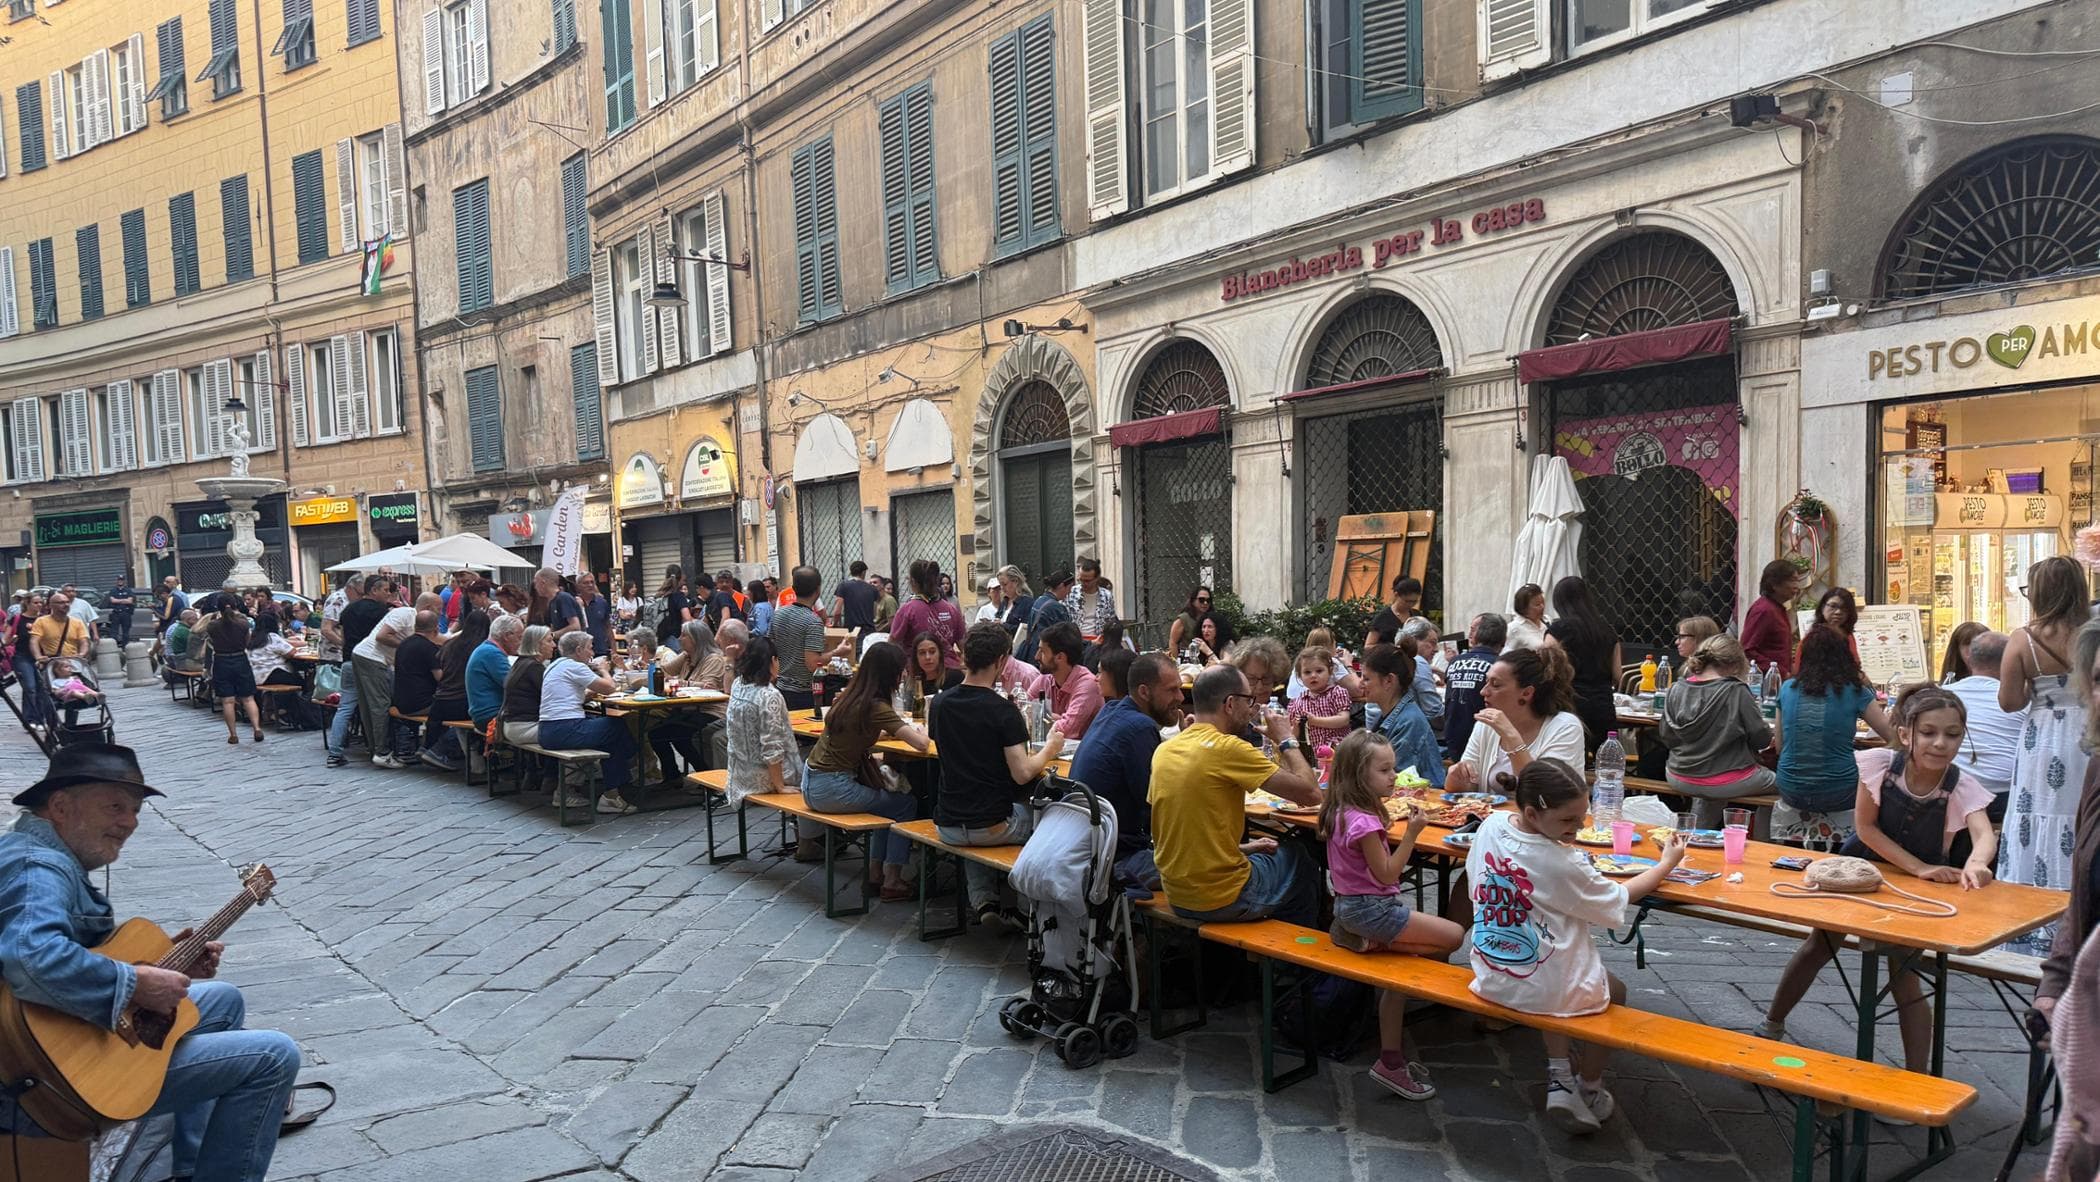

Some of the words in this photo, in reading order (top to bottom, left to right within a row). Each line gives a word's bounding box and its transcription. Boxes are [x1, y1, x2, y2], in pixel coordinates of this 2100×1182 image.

[1221, 243, 1363, 300] Biancheria
[1373, 228, 1424, 268] per
[1430, 218, 1462, 246] la
[1471, 198, 1546, 235] casa
[1868, 336, 1982, 381] PESTO
[2001, 337, 2028, 353] PER
[1615, 451, 1665, 474] BOLLO
[295, 501, 349, 519] FASTWEB
[382, 504, 416, 520] express
[64, 520, 120, 536] MAGLIERIE
[553, 506, 569, 557] Garden
[1483, 905, 1528, 928] POP
